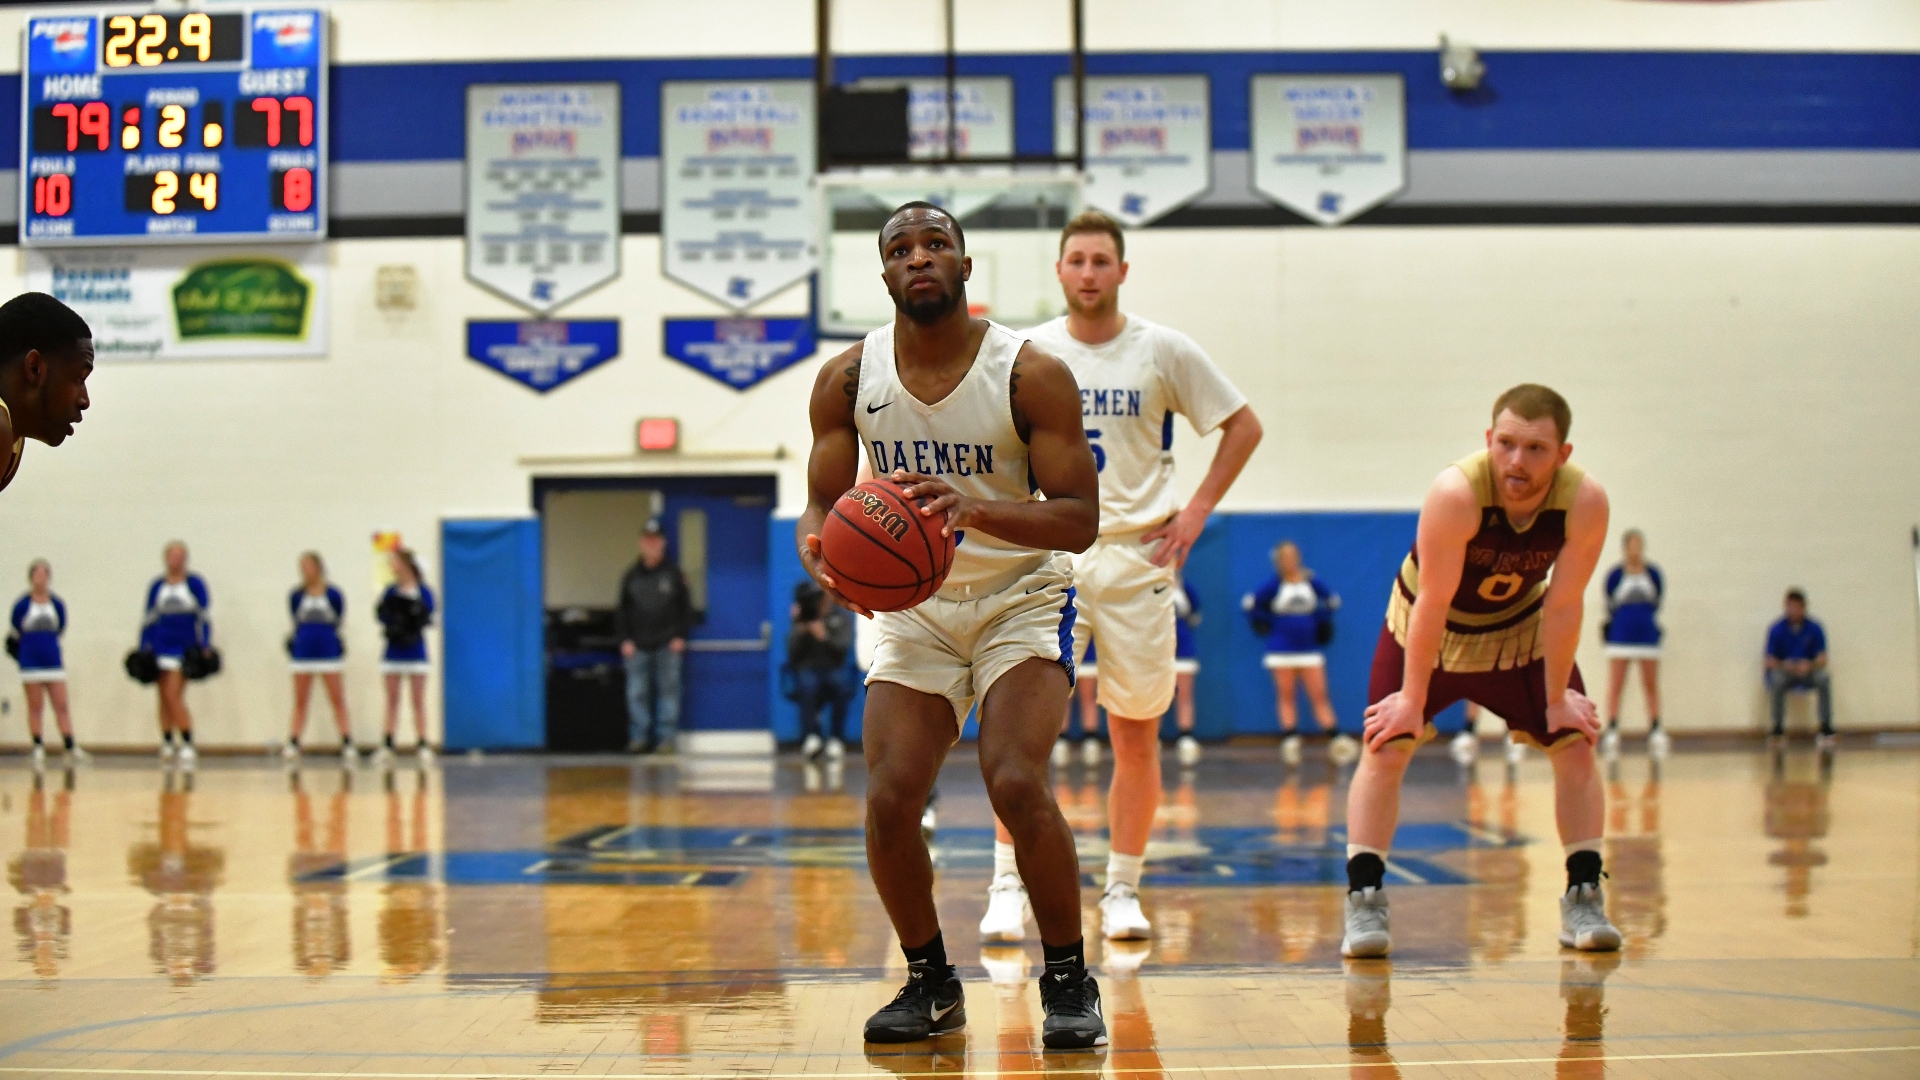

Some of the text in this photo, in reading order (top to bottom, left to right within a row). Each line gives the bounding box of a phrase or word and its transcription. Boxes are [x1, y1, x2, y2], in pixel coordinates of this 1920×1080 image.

[105, 13, 211, 67] 22.9
[43, 74, 102, 100] HOME
[52, 102, 109, 151] 79
[159, 104, 185, 148] 2
[252, 96, 313, 146] 77
[35, 173, 71, 216] 10
[283, 167, 312, 212] 8
[871, 439, 994, 477] DAEMEN
[845, 488, 909, 543] Wilson
[1477, 572, 1523, 601] 0
